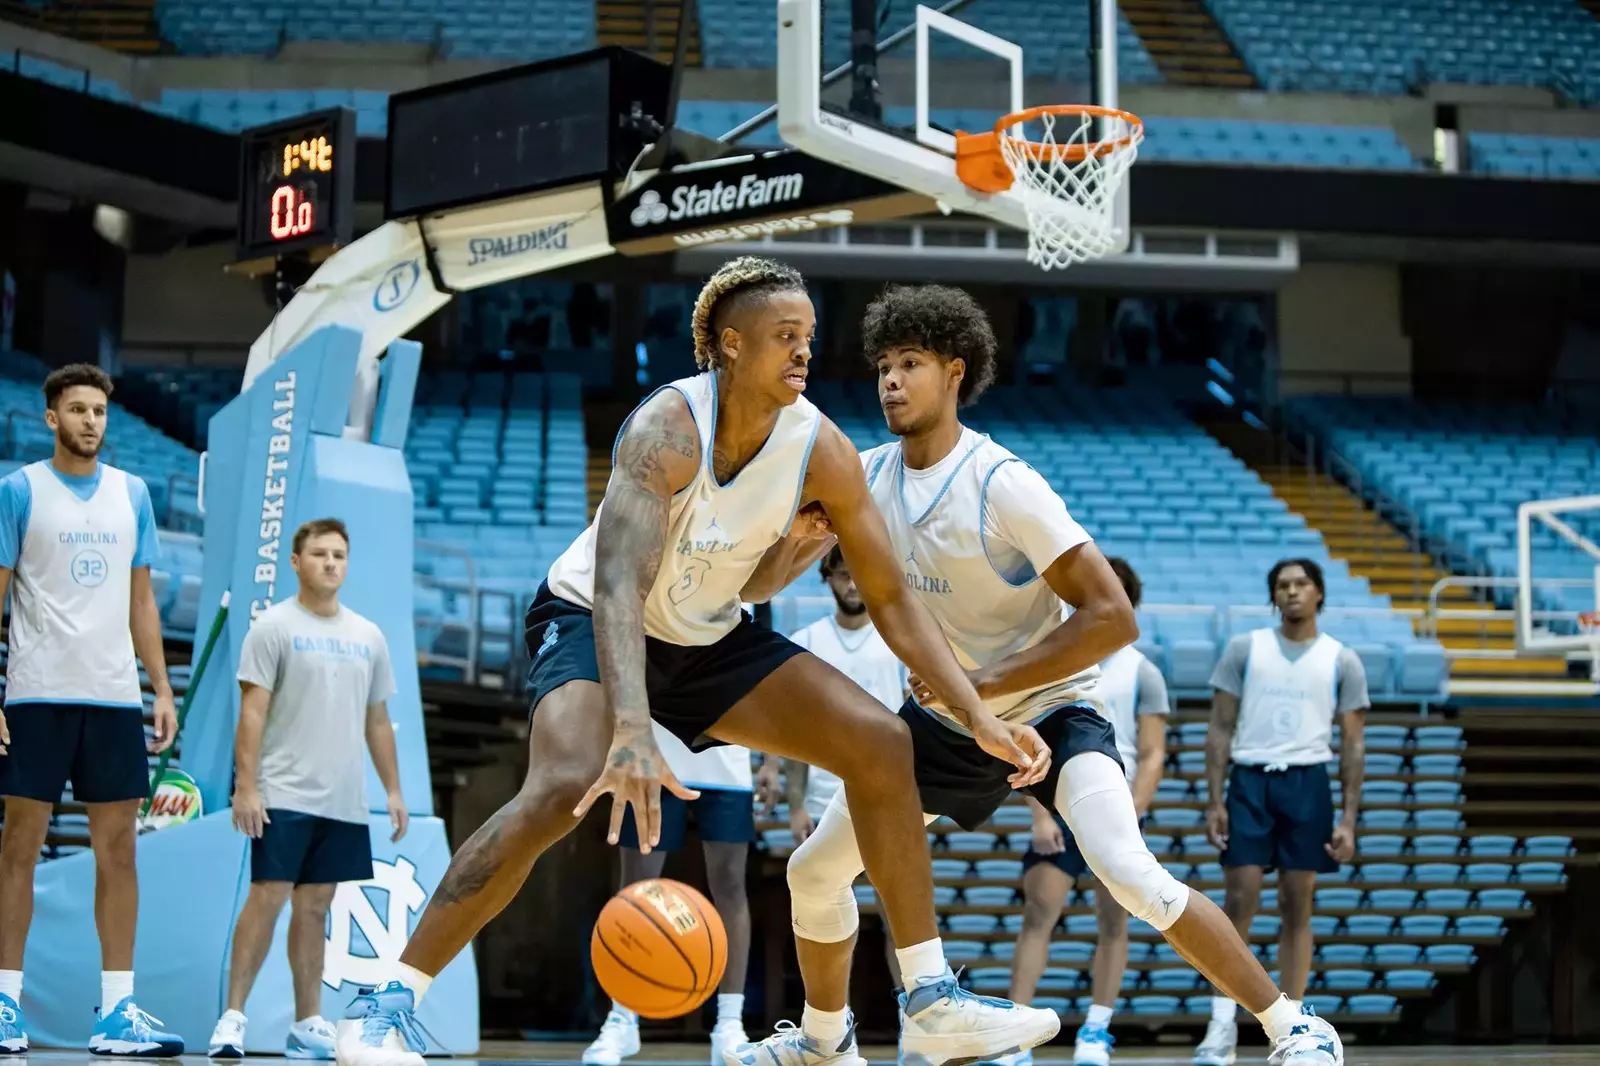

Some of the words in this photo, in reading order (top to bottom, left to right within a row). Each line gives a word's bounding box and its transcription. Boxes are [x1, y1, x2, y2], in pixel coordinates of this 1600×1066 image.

[271, 186, 312, 238] 0.0
[467, 221, 568, 266] SPALDING
[58, 532, 118, 544] CAROLINA
[78, 560, 102, 577] 32
